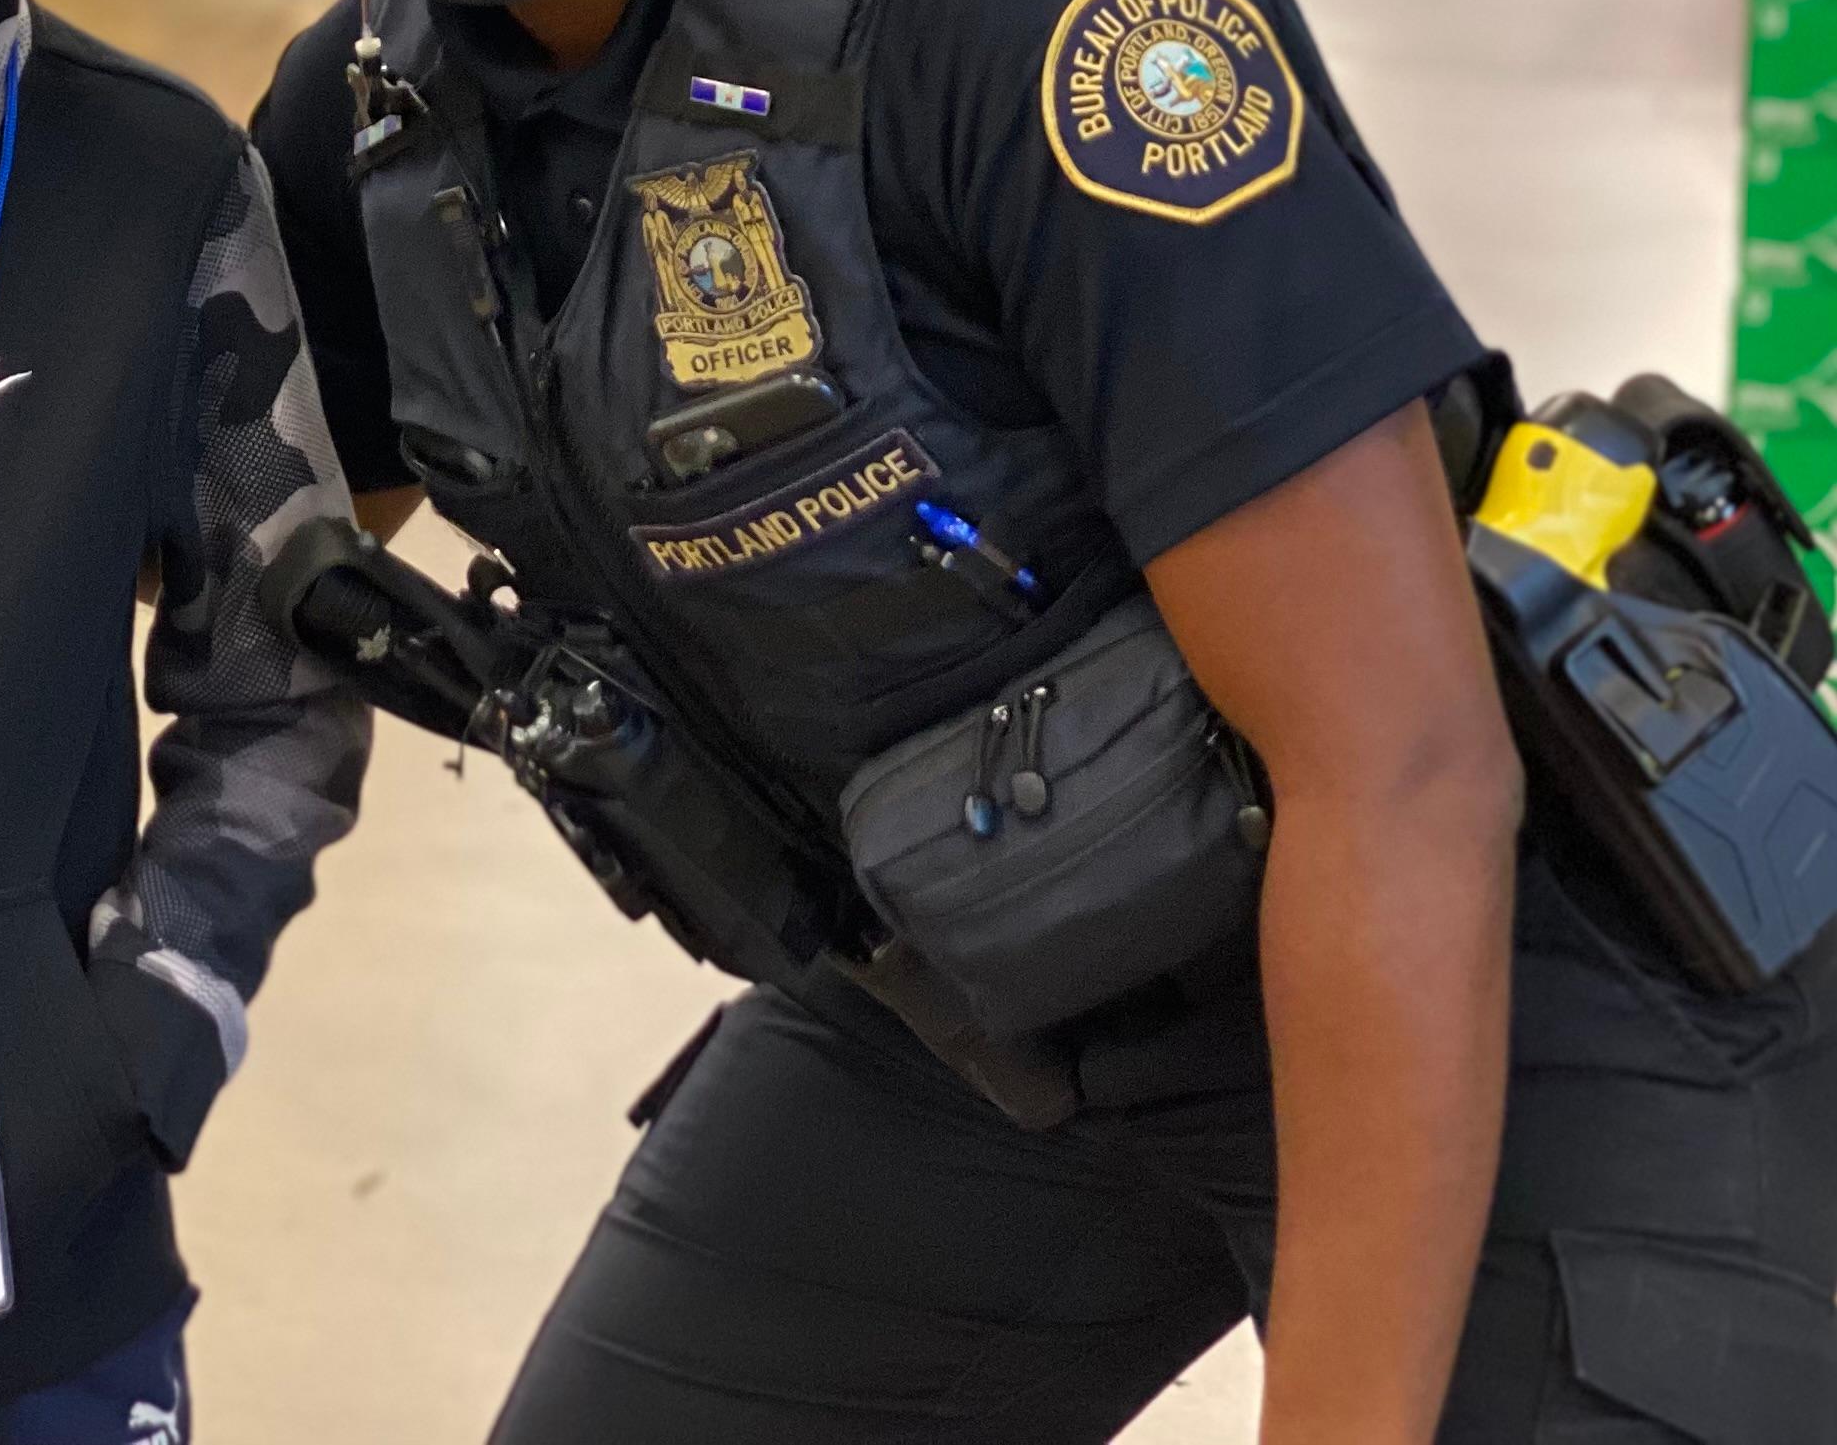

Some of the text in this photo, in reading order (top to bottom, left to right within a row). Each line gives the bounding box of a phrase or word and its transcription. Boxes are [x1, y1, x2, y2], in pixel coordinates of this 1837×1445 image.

[1069, 7, 1126, 142] BUREAU
[1123, 86, 1147, 111] OF
[1194, 35, 1232, 104] OREGON
[1140, 107, 1183, 134] CITY
[1141, 85, 1275, 178] PORTLAND
[662, 288, 800, 335] PORTLAND POLICE
[690, 335, 794, 374] OFFICER
[647, 446, 921, 571] PORTLAND POLICE
